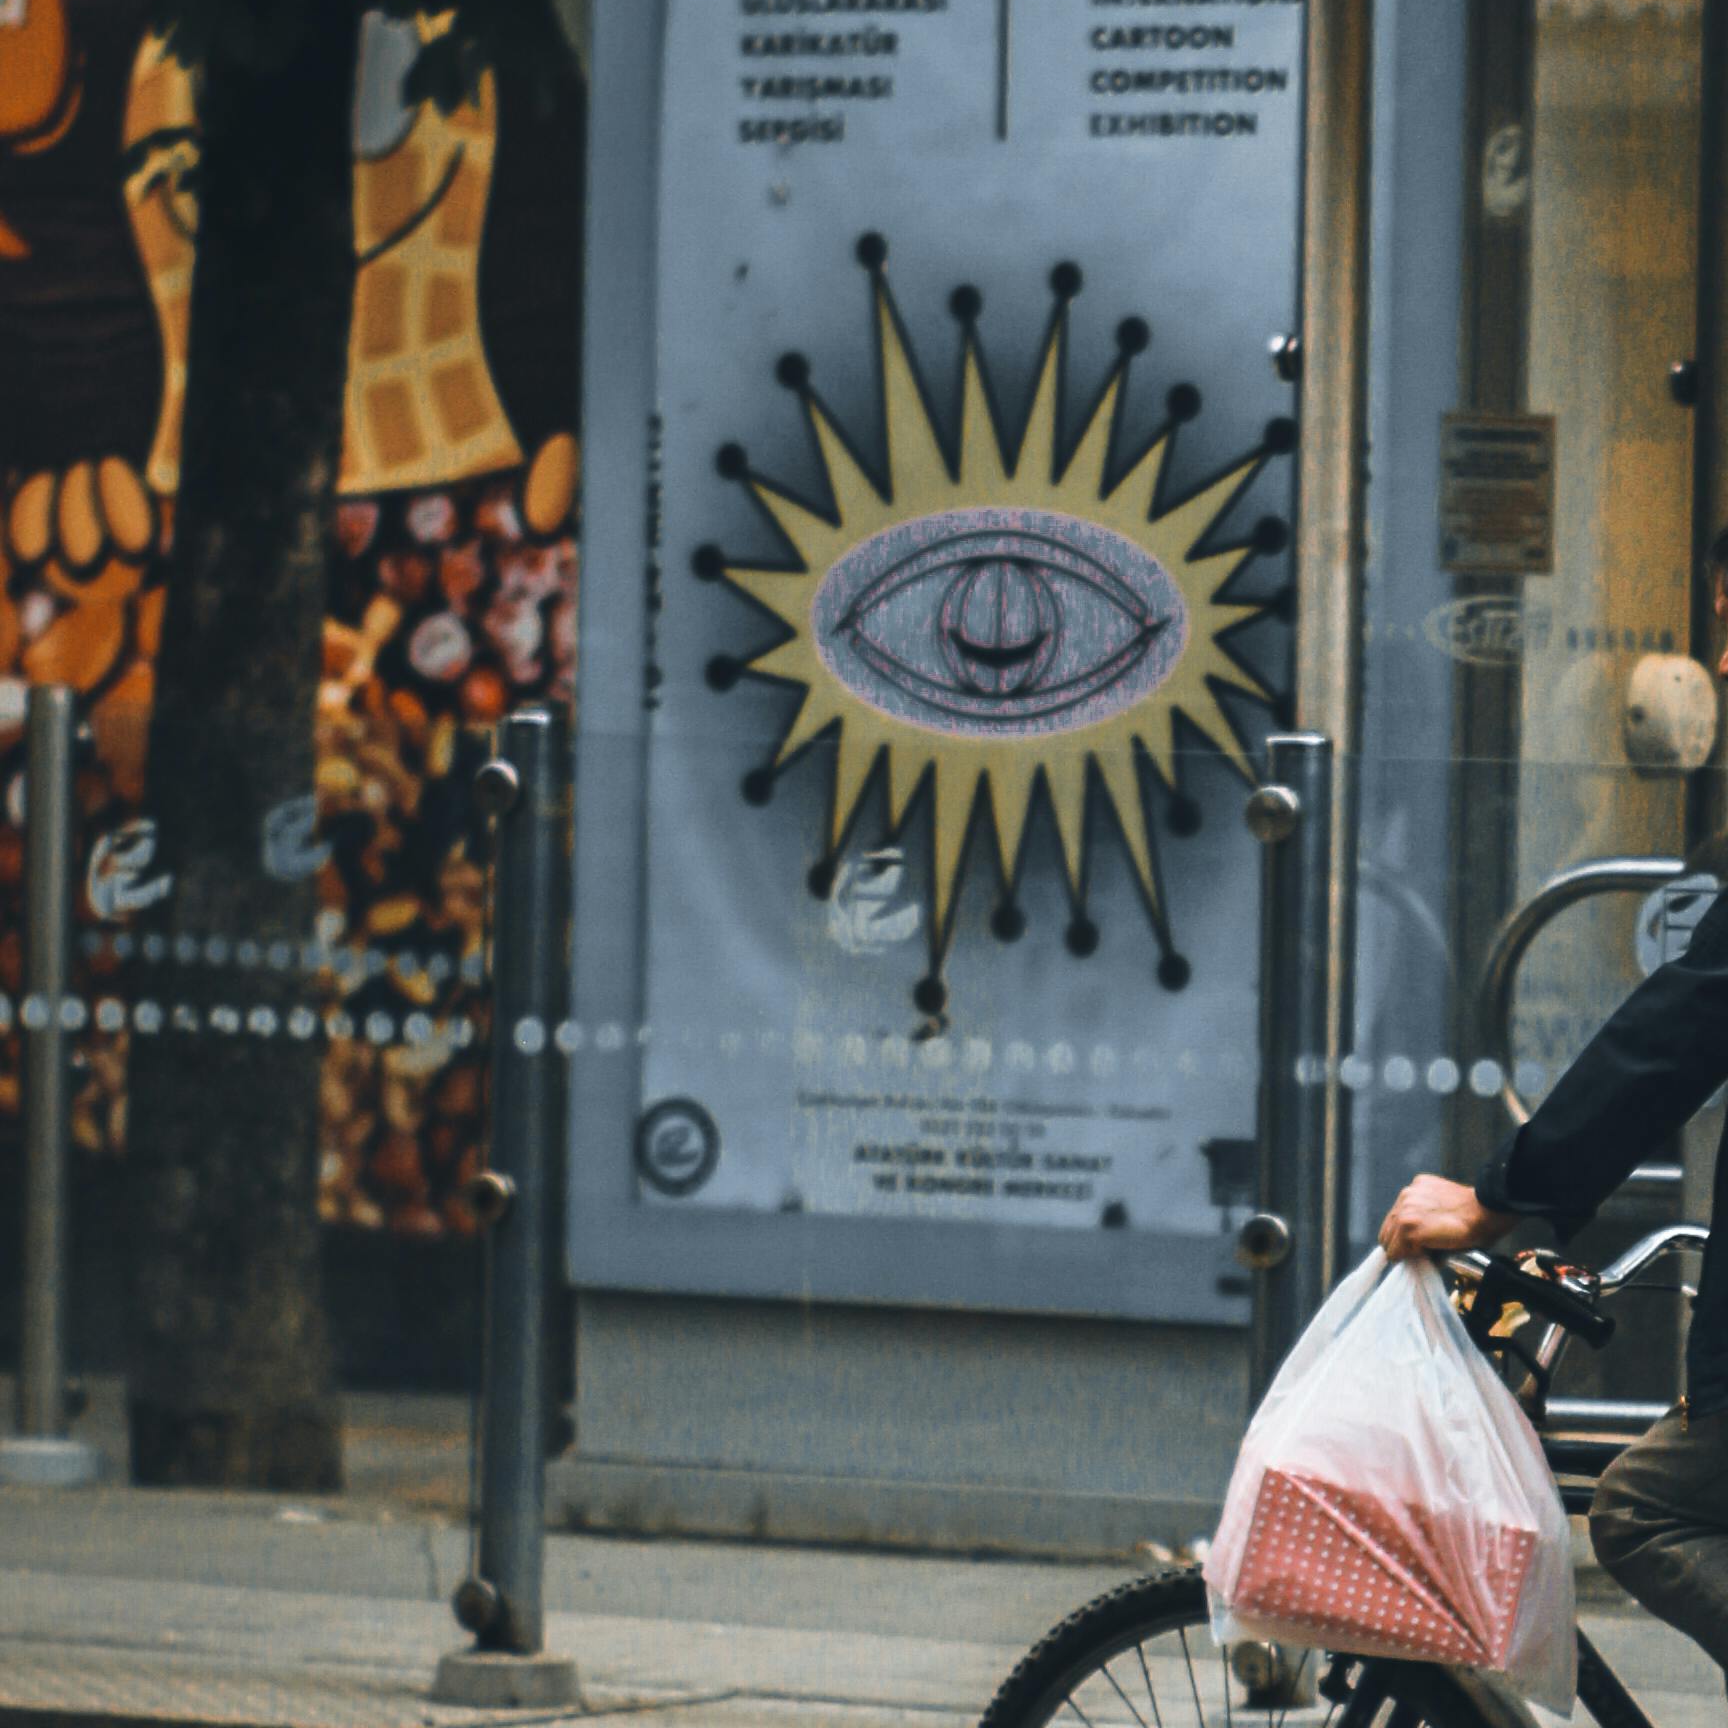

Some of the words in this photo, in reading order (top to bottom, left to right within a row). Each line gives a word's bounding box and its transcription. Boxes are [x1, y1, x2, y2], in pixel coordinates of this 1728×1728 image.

[1091, 24, 1233, 51] CARTOON
[1090, 68, 1288, 94] COMPETITION
[1090, 112, 1257, 138] EXHIBITION
